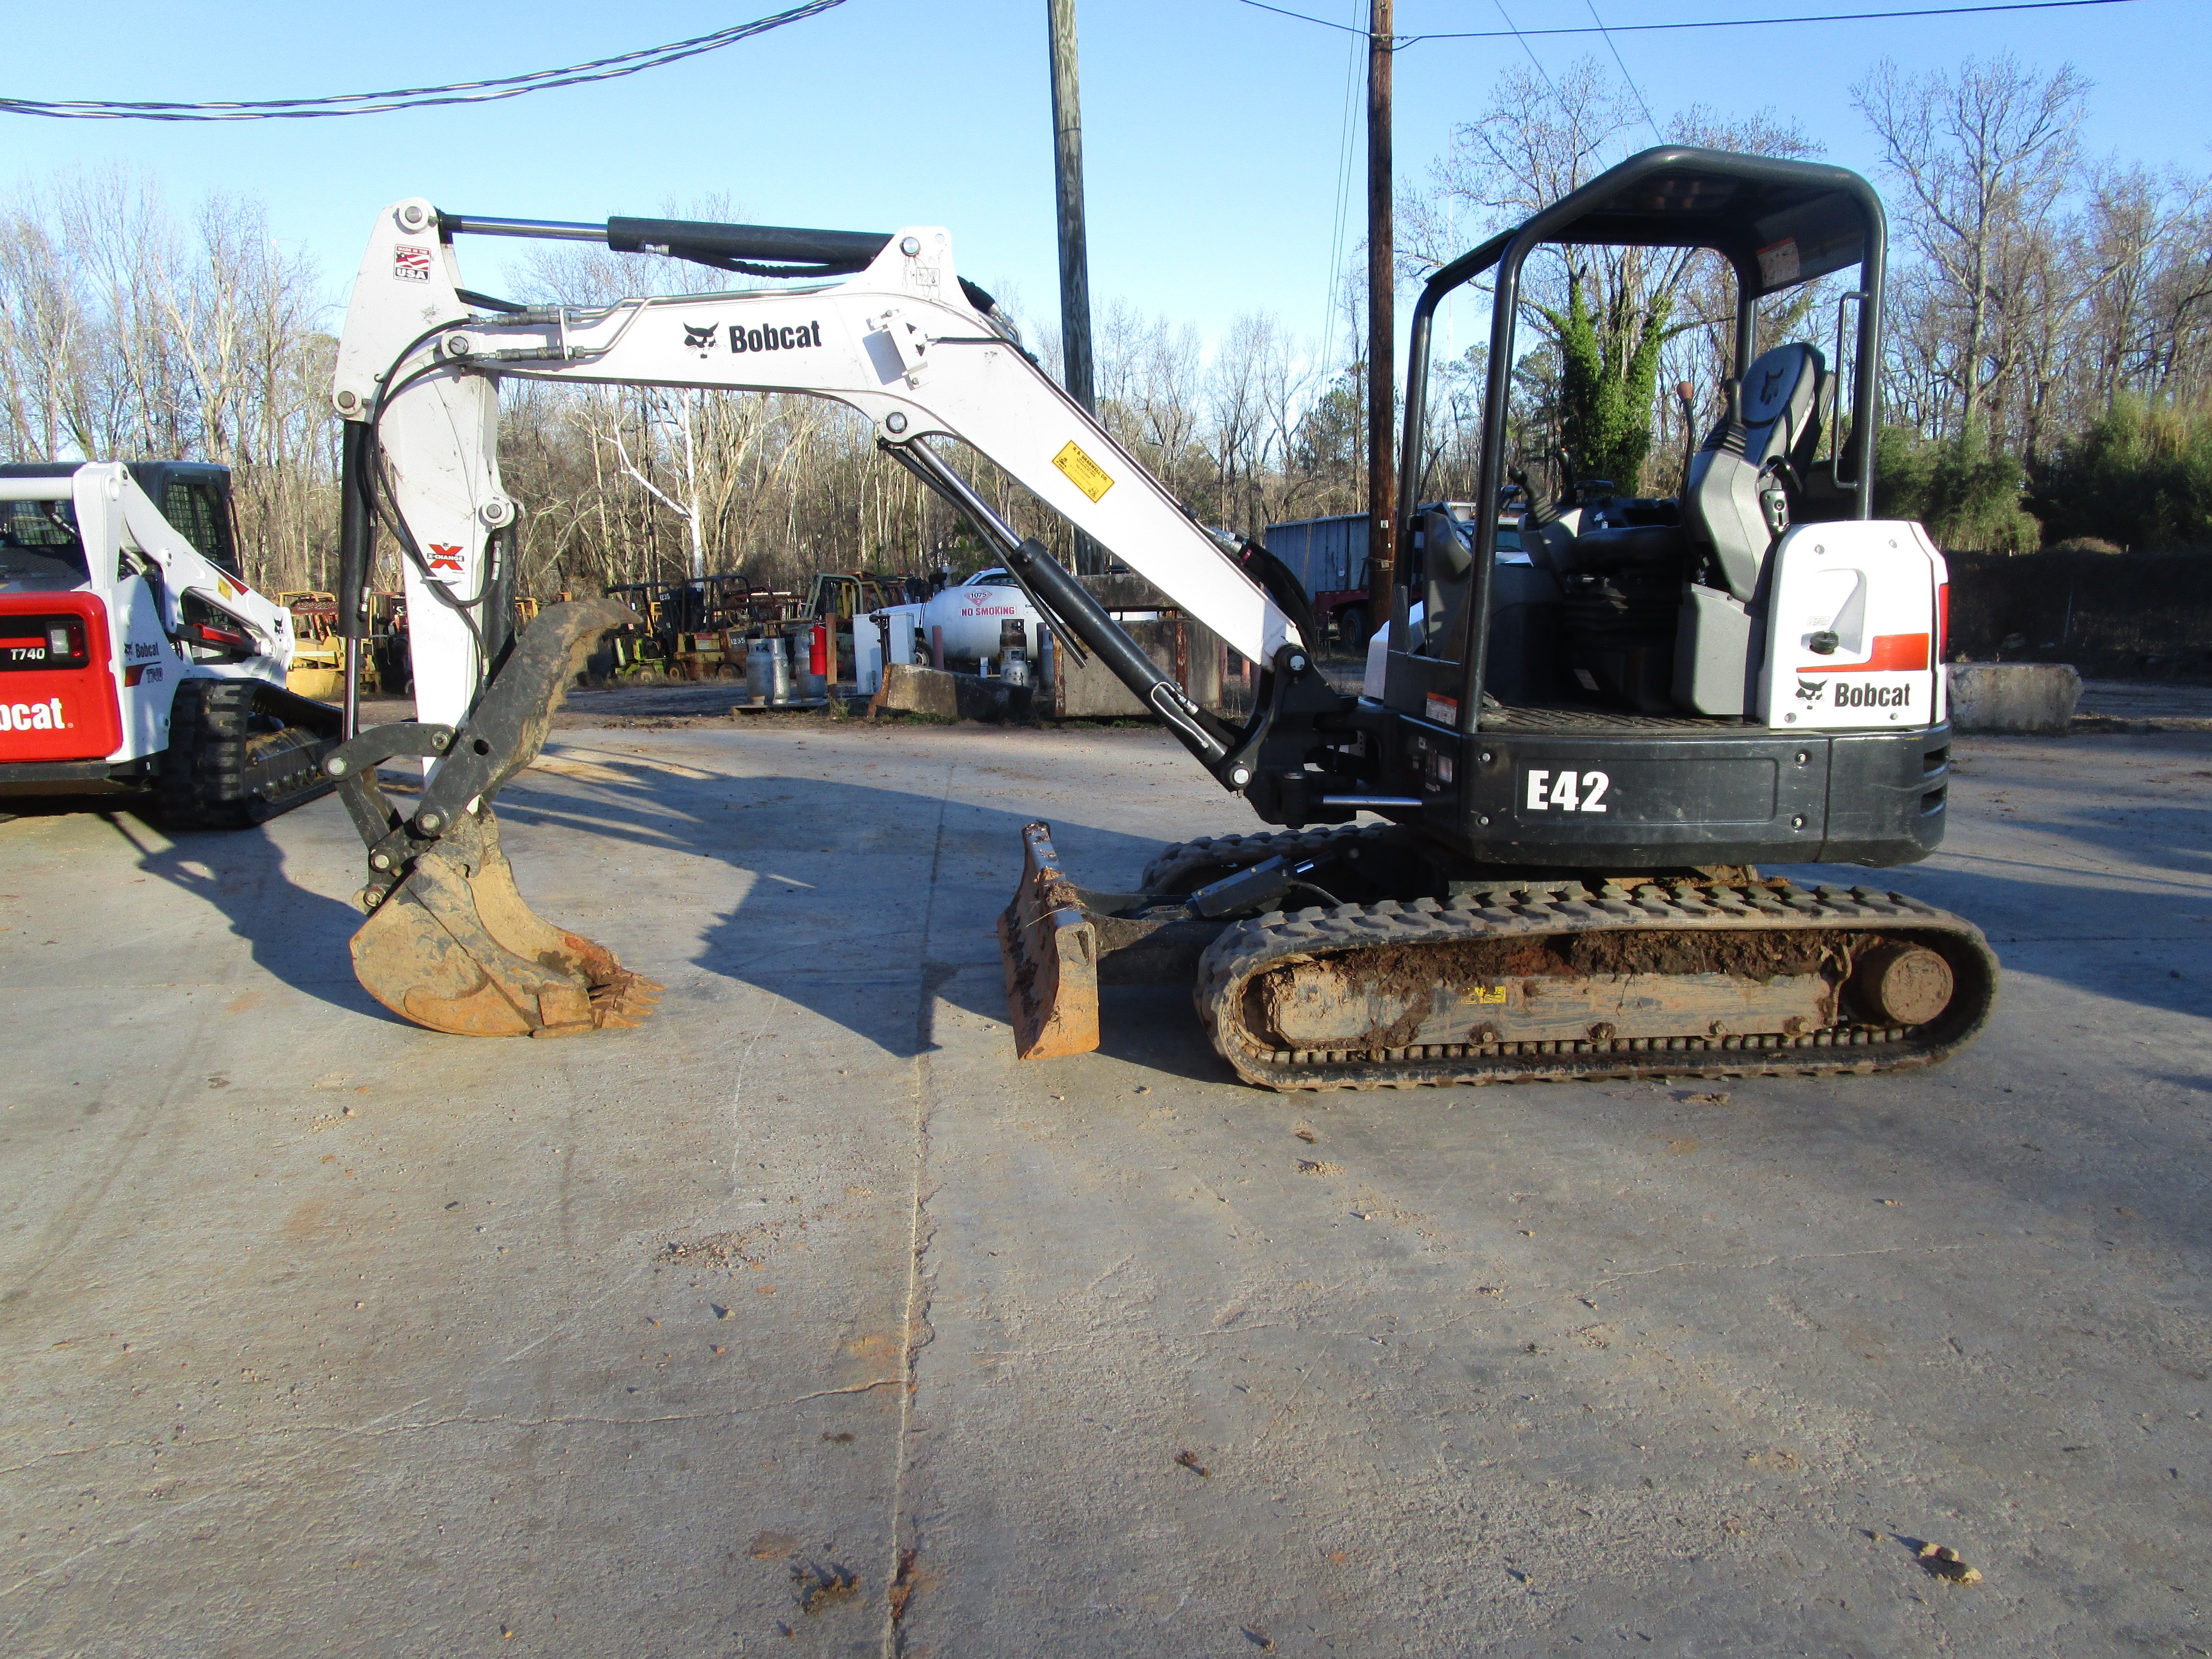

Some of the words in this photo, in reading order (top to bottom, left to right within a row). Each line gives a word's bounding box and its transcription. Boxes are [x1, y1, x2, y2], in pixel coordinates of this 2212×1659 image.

[396, 268, 427, 280] USA
[729, 320, 822, 353] Bobcat
[1081, 455, 1100, 475] BRASWELL
[962, 608, 973, 616] NO
[975, 606, 1015, 616] SMOKING
[10, 647, 45, 660] T740
[135, 641, 159, 658] Bobcat
[1835, 683, 1910, 707] Bobcat
[1527, 770, 1609, 812] E42
